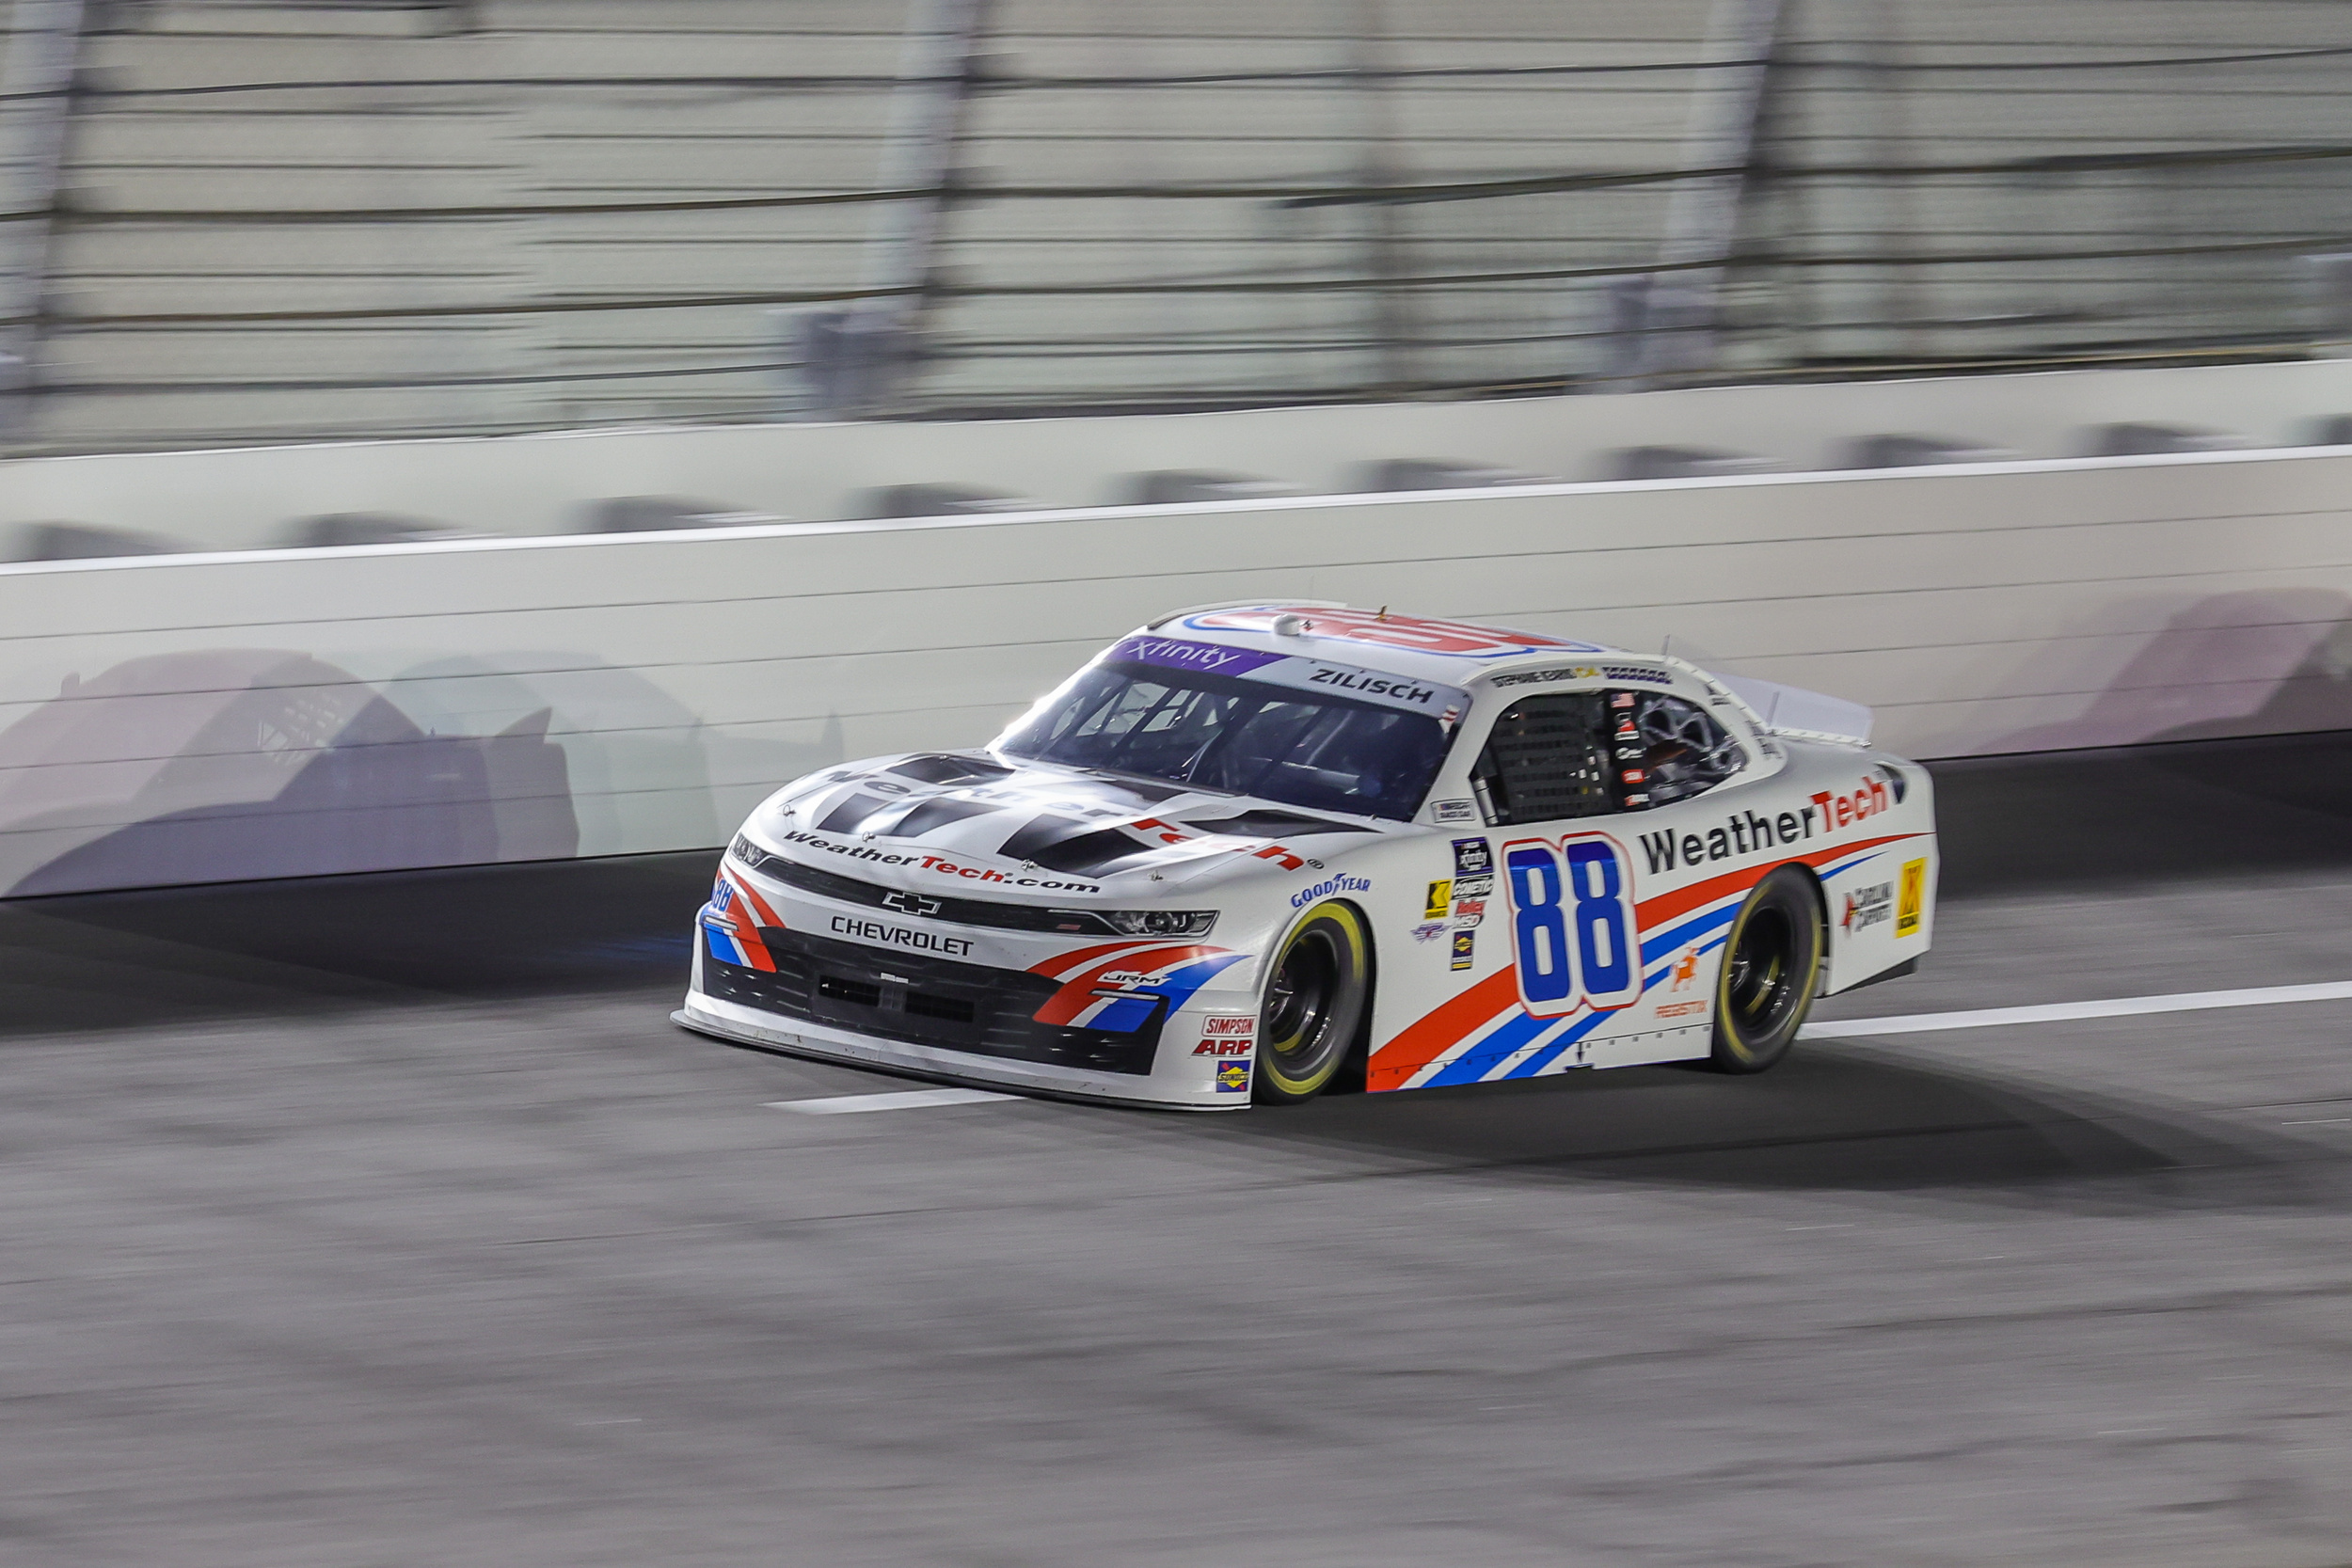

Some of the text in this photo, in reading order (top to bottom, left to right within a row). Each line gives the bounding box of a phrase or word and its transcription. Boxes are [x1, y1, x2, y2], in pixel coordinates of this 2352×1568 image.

[1126, 639, 1242, 670] xfinity
[1309, 669, 1435, 704] ZILISCH
[1636, 776, 1890, 875] WeatherTech
[713, 879, 734, 911] 88
[831, 915, 974, 957] CHEVROLET
[1505, 837, 1633, 1006] 88
[1104, 974, 1161, 985] JRM
[1206, 1018, 1255, 1034] SIMPSON
[1191, 1039, 1253, 1055] ARP
